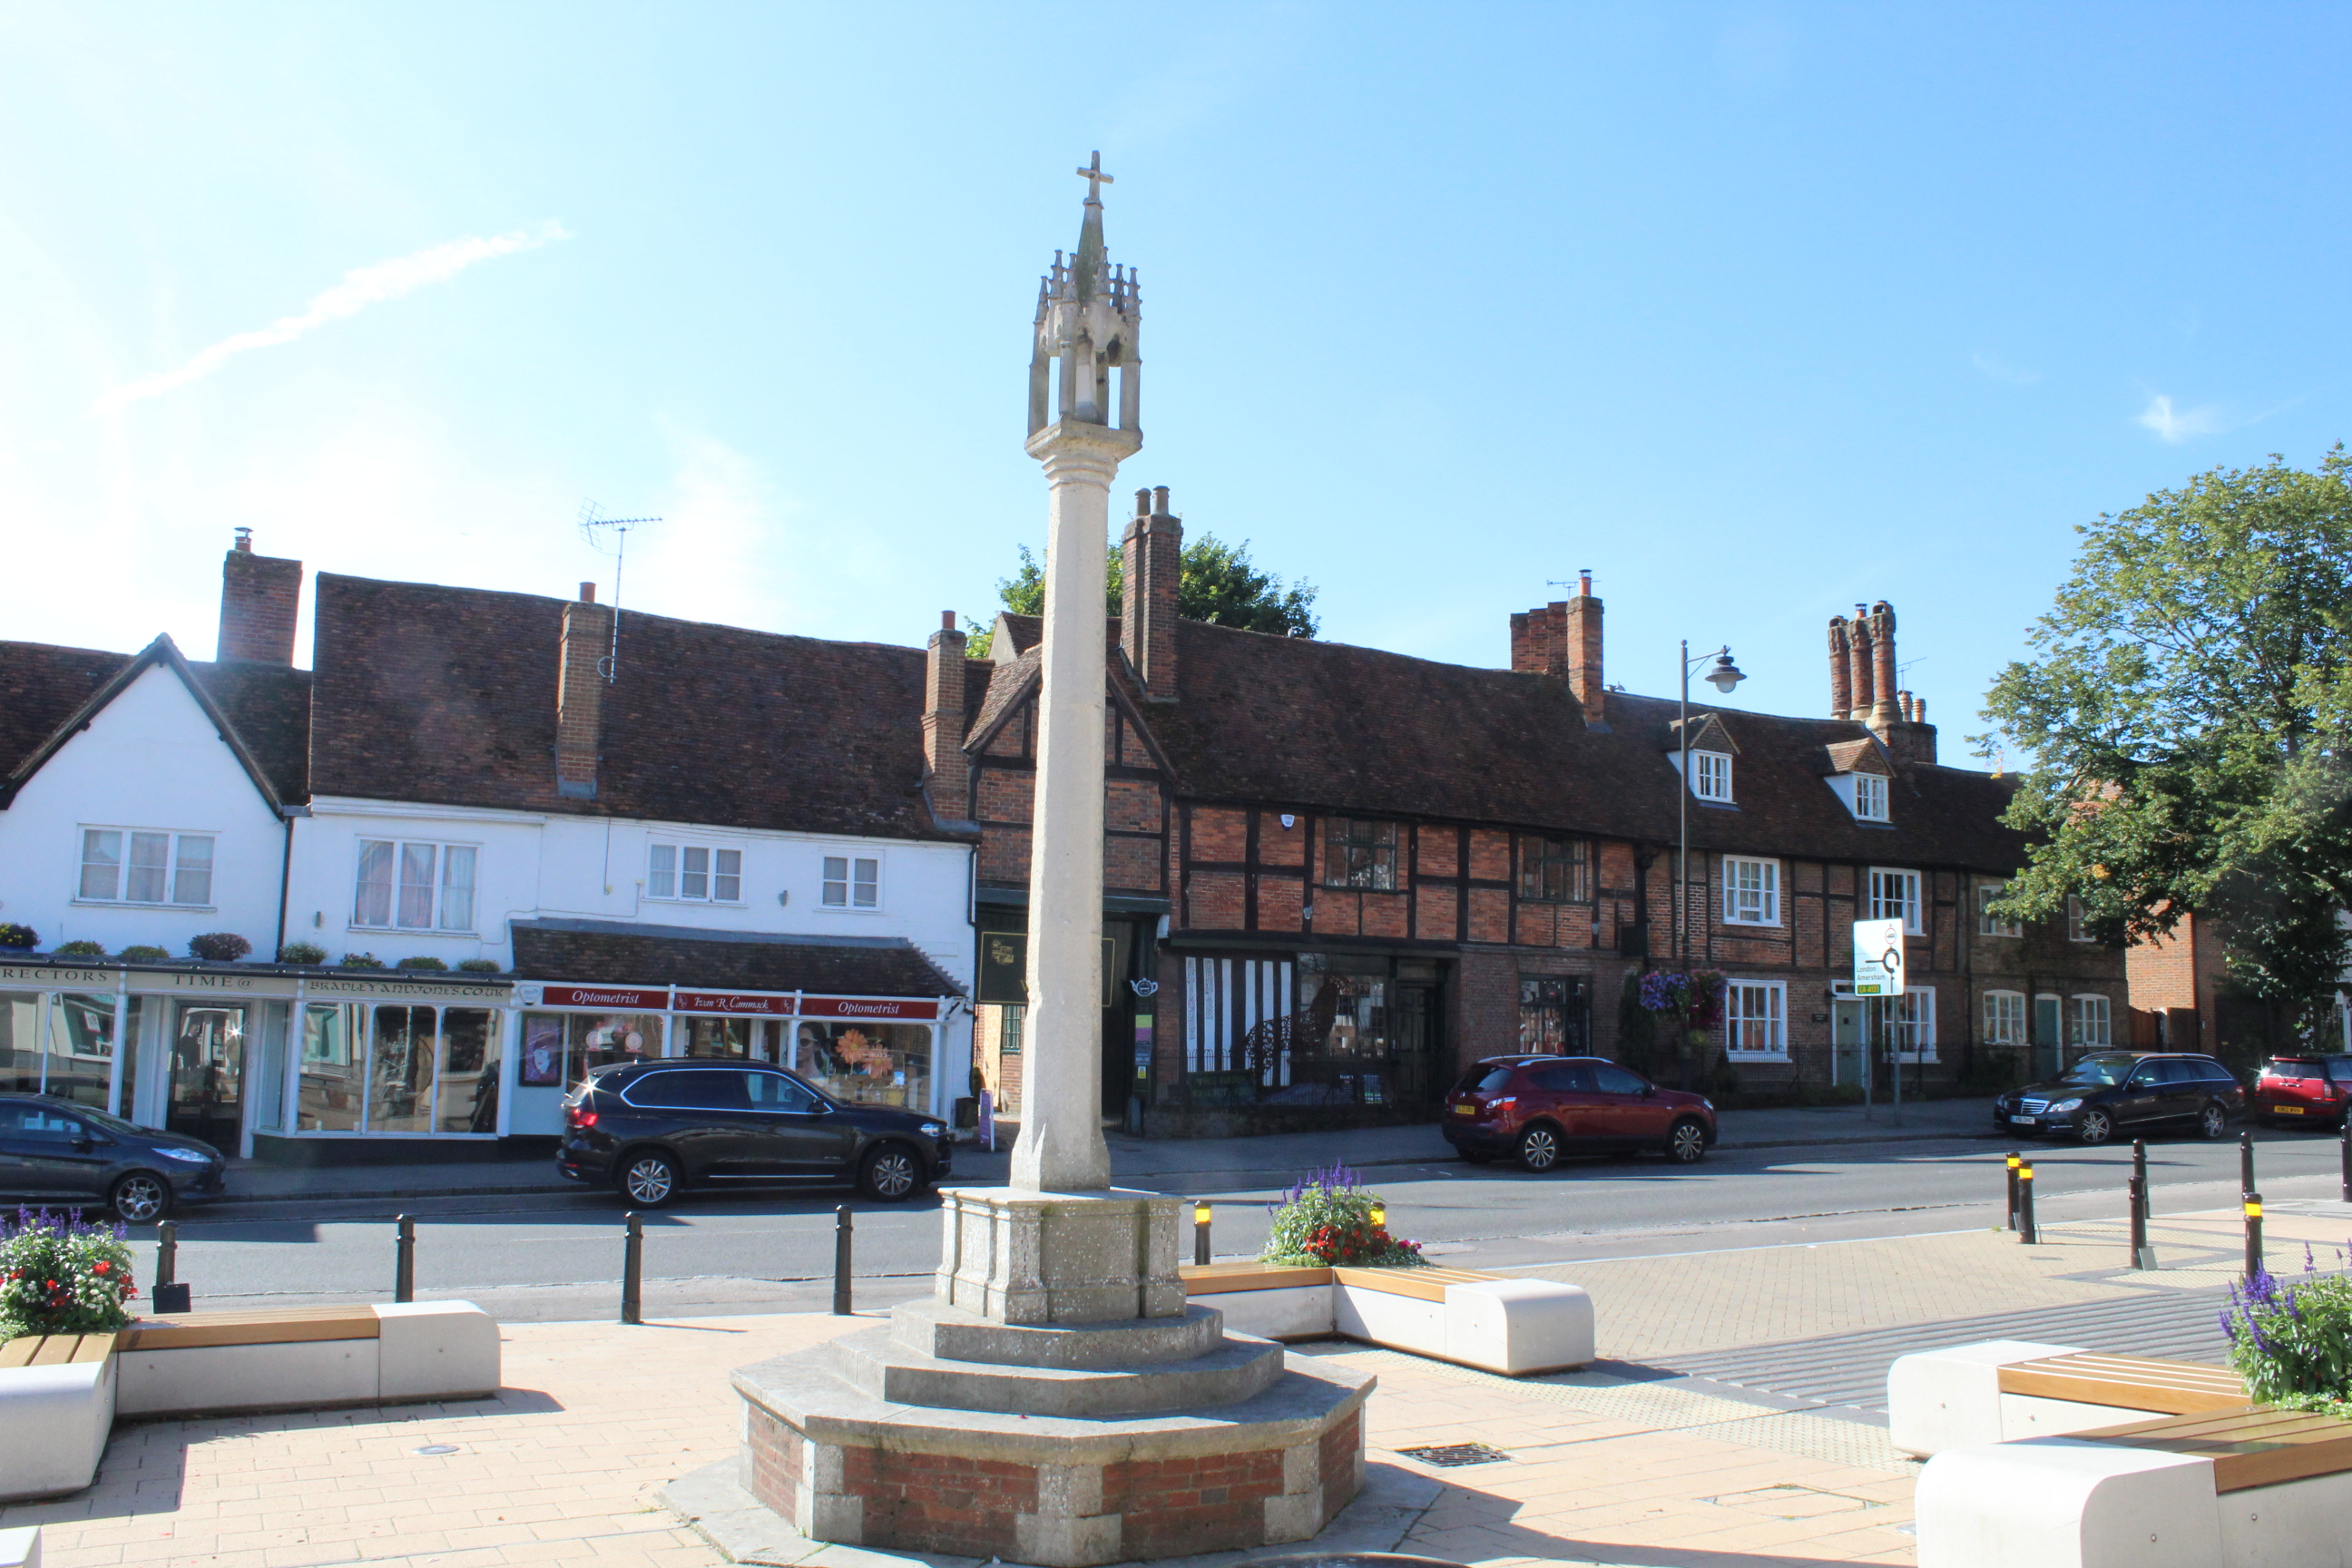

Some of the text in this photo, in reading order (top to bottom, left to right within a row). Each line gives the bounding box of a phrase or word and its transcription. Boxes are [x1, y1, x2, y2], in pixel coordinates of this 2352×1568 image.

[572, 990, 640, 1004] Optometrist
[694, 996, 714, 1007] Ivan
[730, 995, 769, 1009] Cammack
[838, 1001, 900, 1014] Optometrist
